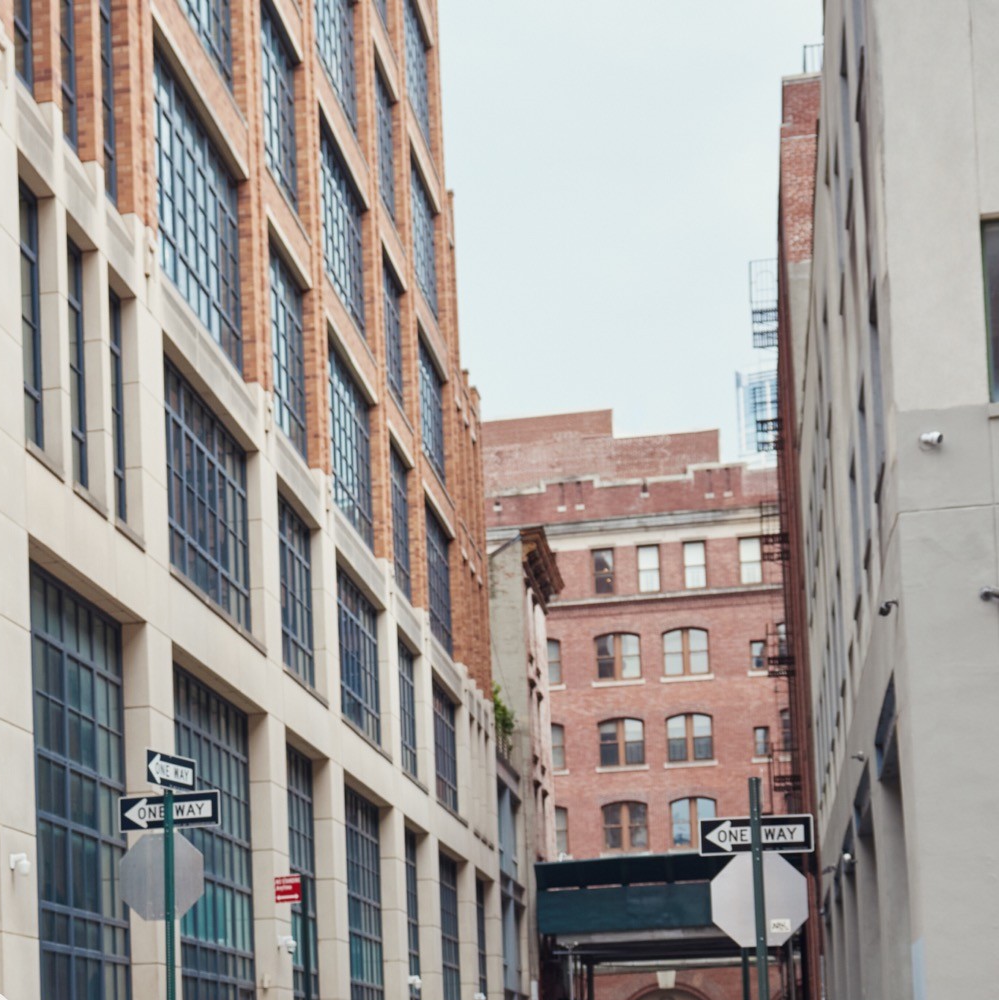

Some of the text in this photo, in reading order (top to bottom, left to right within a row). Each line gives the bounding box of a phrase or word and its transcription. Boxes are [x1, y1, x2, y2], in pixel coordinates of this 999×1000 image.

[154, 761, 189, 782] ONE WAY
[137, 803, 204, 820] ONE WAY
[717, 827, 797, 843] ONE WAY
